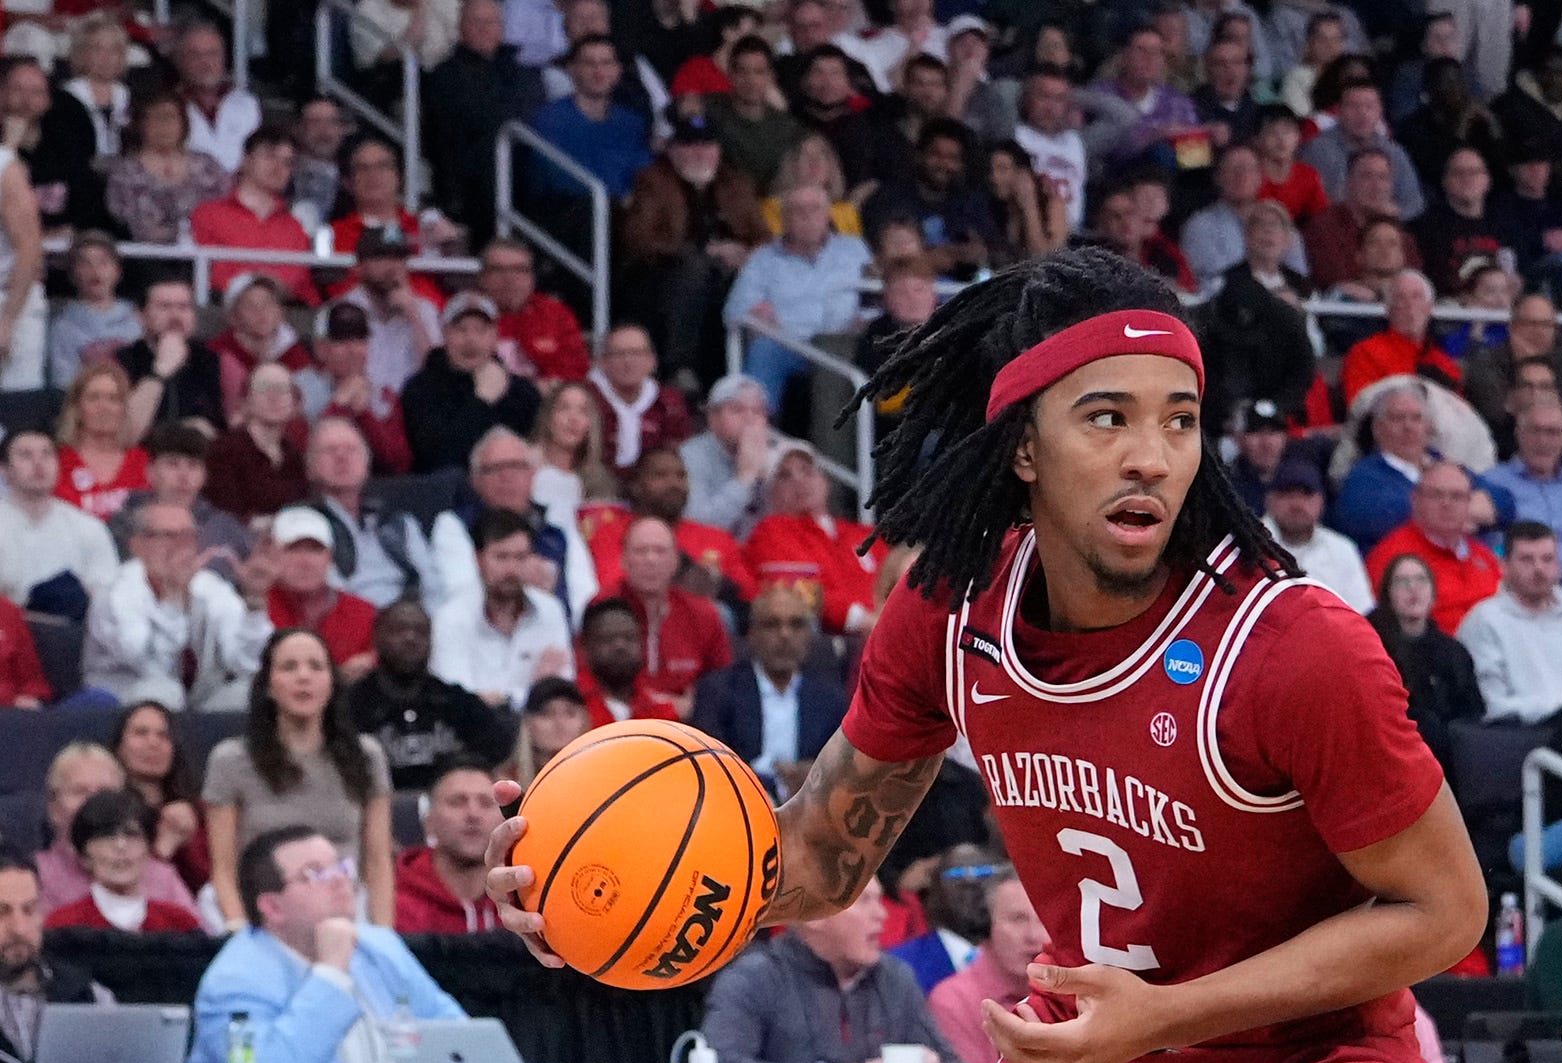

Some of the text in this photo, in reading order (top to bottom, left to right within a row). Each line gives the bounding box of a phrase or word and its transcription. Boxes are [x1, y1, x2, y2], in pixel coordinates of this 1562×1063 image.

[1167, 658, 1201, 676] NCAA
[1152, 714, 1177, 744] SEC
[982, 752, 1206, 852] RAZORBACKS
[642, 875, 731, 979] NCAA
[1056, 828, 1161, 971] 2
